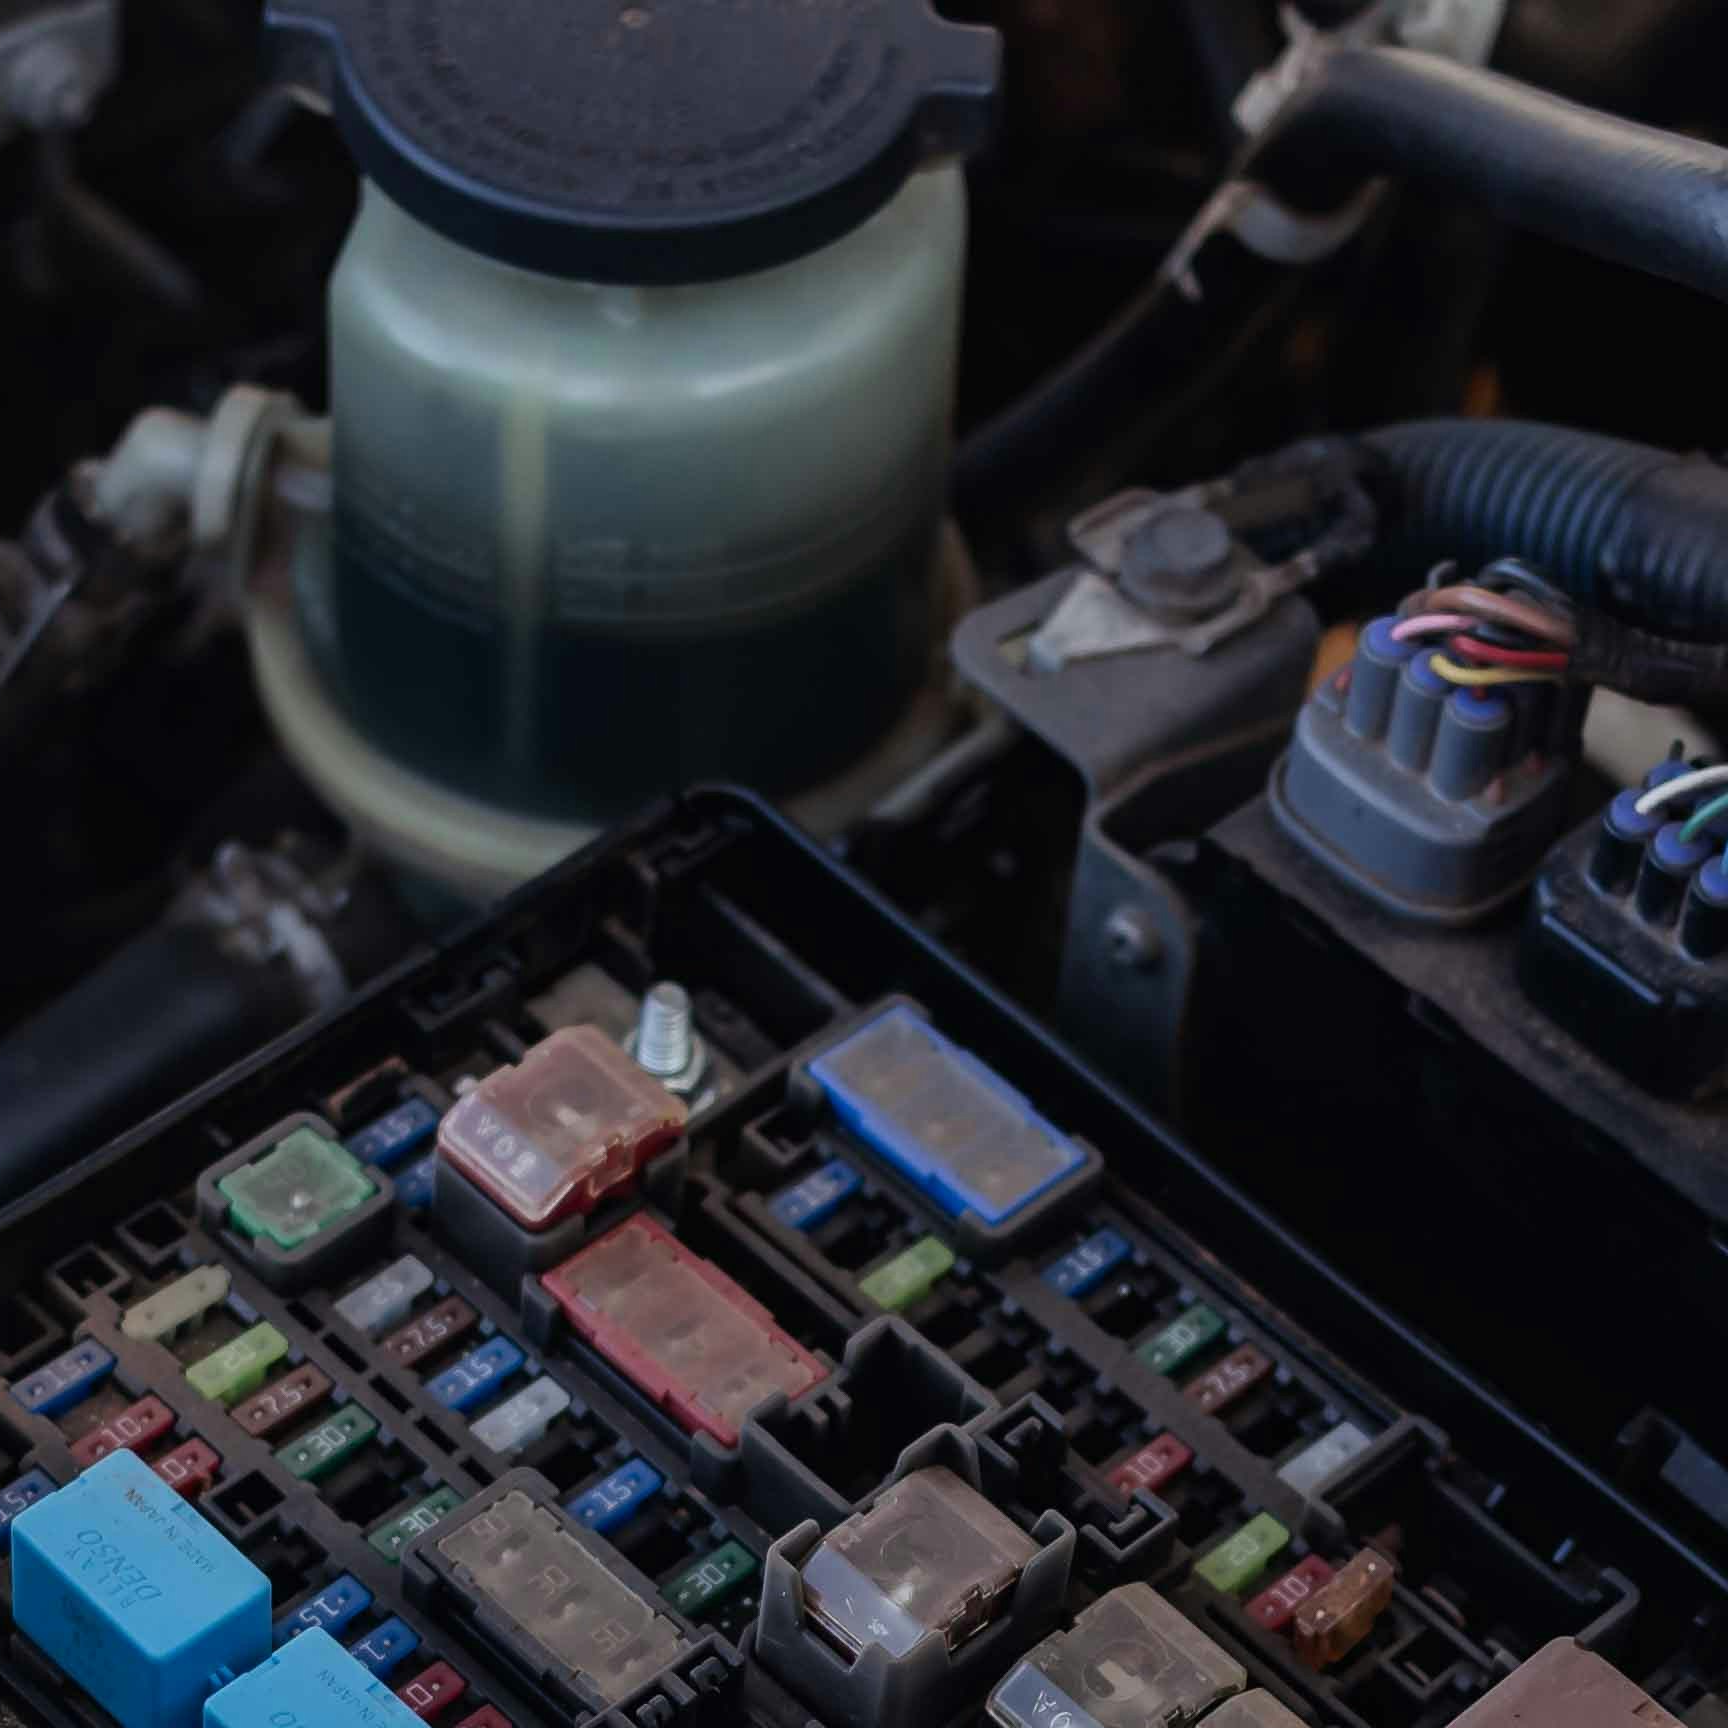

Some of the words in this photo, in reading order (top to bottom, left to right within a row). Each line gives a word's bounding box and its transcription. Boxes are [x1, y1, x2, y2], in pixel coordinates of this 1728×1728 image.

[414, 1314, 448, 1348] 7.5
[458, 1355, 492, 1389] 15
[267, 1384, 304, 1415] 7.5
[102, 1414, 142, 1447] 10
[308, 1427, 344, 1458] 30
[1129, 1451, 1160, 1481] 10
[592, 1478, 631, 1511] 15
[400, 1505, 440, 1537] 30
[77, 1529, 163, 1601] DENSO
[687, 1564, 726, 1597] 30
[1274, 1576, 1309, 1606] 10
[299, 1598, 338, 1626] 15
[319, 1669, 361, 1705] JAPAN
